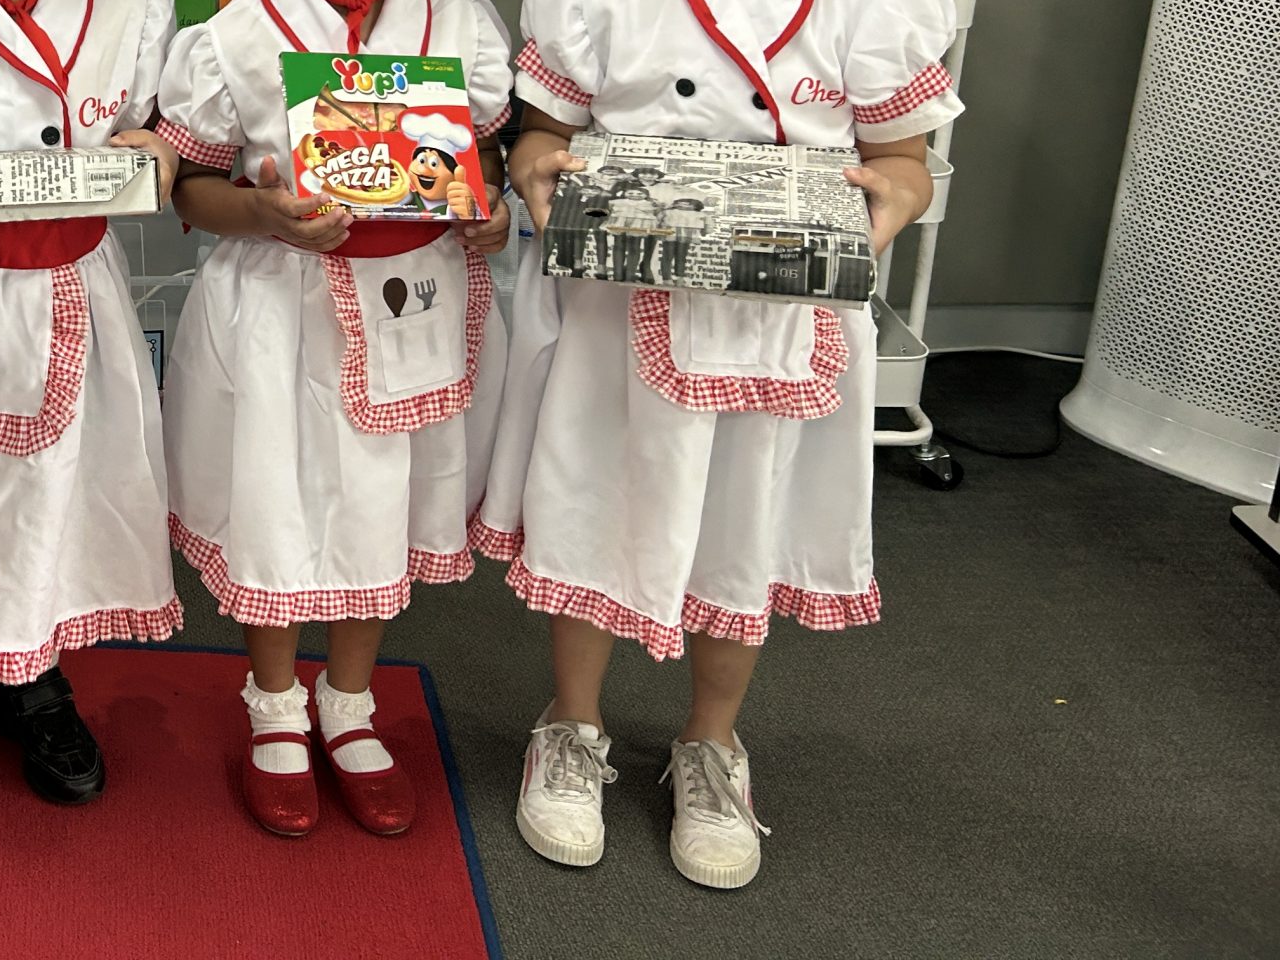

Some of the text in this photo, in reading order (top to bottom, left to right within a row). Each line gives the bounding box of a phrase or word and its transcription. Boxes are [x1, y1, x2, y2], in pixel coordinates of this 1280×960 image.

[332, 58, 408, 98] Yupi
[611, 146, 783, 163] perfect pizza
[649, 139, 711, 150] search
[314, 143, 390, 178] MEGA
[327, 167, 391, 189] PIZZA
